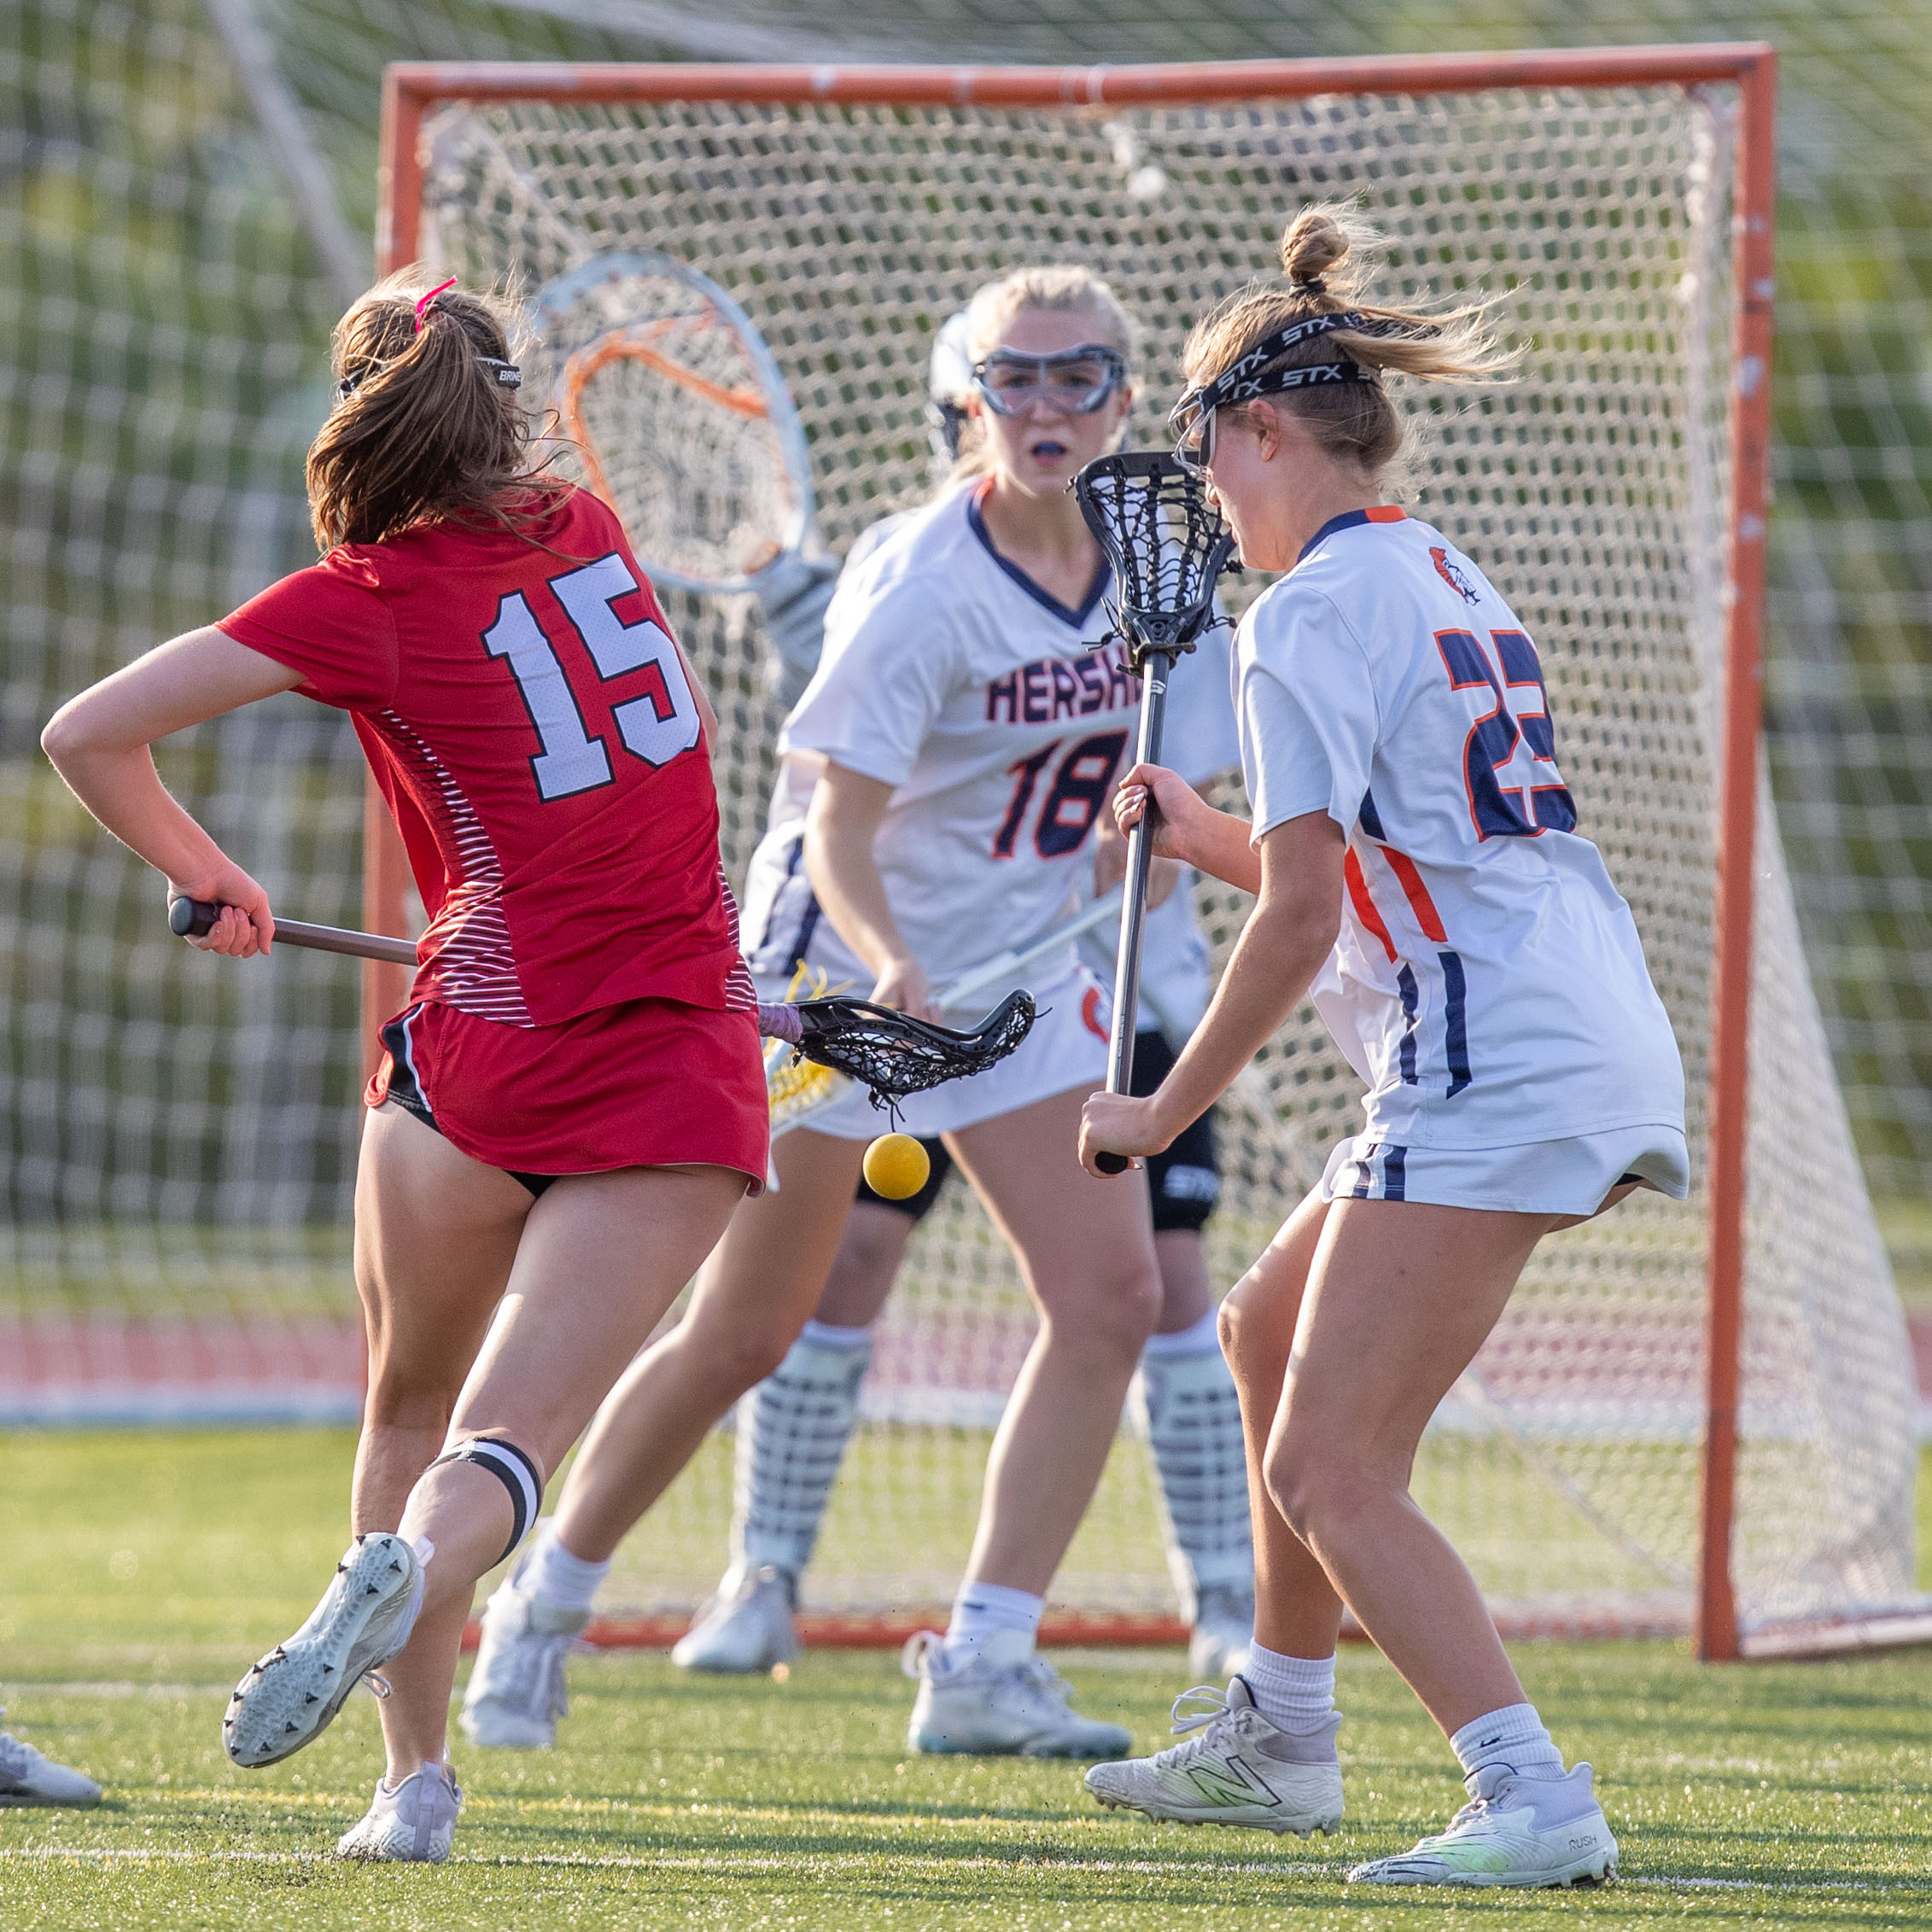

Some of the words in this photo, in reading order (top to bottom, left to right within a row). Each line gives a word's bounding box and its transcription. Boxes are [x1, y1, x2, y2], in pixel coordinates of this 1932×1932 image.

[1281, 315, 1337, 347] STX
[1217, 345, 1270, 394] STX
[1281, 364, 1343, 388] STX
[1229, 376, 1264, 400] TX
[479, 550, 701, 804] 15
[990, 727, 1130, 861] 18
[1567, 1833, 1597, 1852] RUSH
